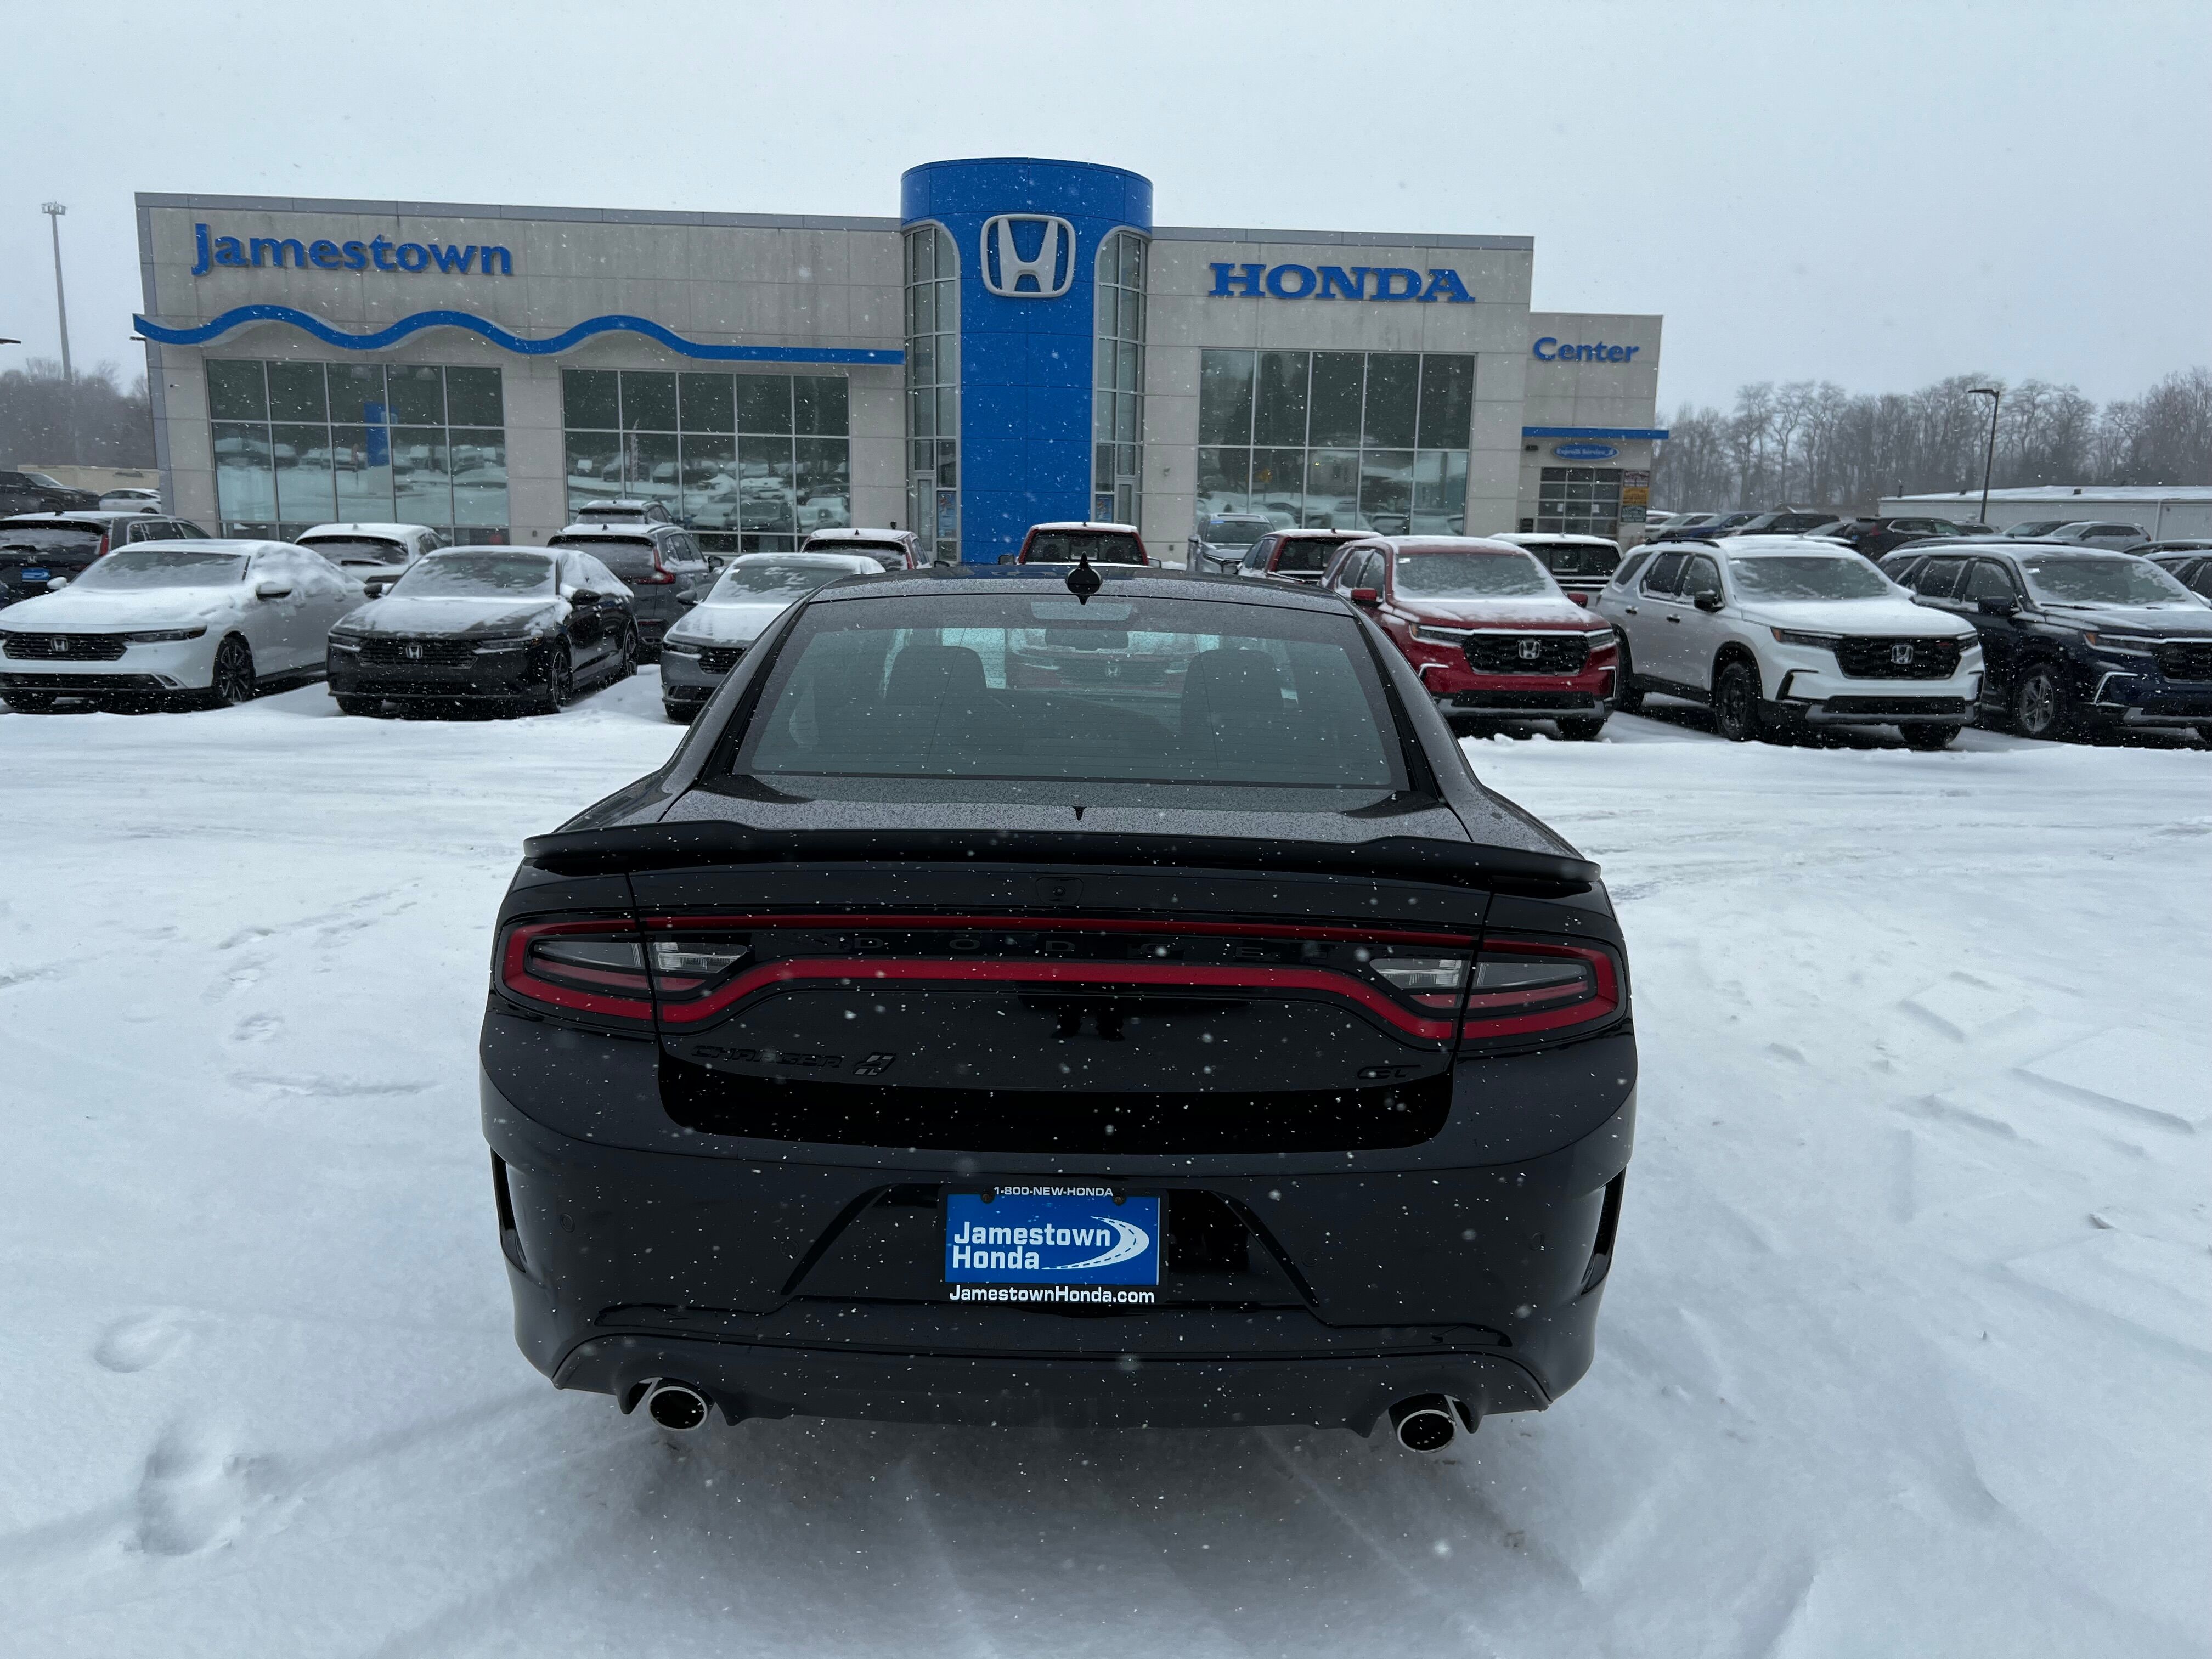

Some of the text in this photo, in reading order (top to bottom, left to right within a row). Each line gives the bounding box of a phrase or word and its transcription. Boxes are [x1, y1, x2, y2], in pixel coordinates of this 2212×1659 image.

[191, 223, 514, 276] Jamestown
[1208, 263, 1476, 303] HONDA
[1533, 337, 1640, 363] Center
[994, 1186, 1114, 1197] 1-800-NEW-HONDA
[953, 1221, 1111, 1246] Jamestown
[952, 1245, 1040, 1269] Honda
[949, 1285, 1155, 1304] JamestownHonda.com
